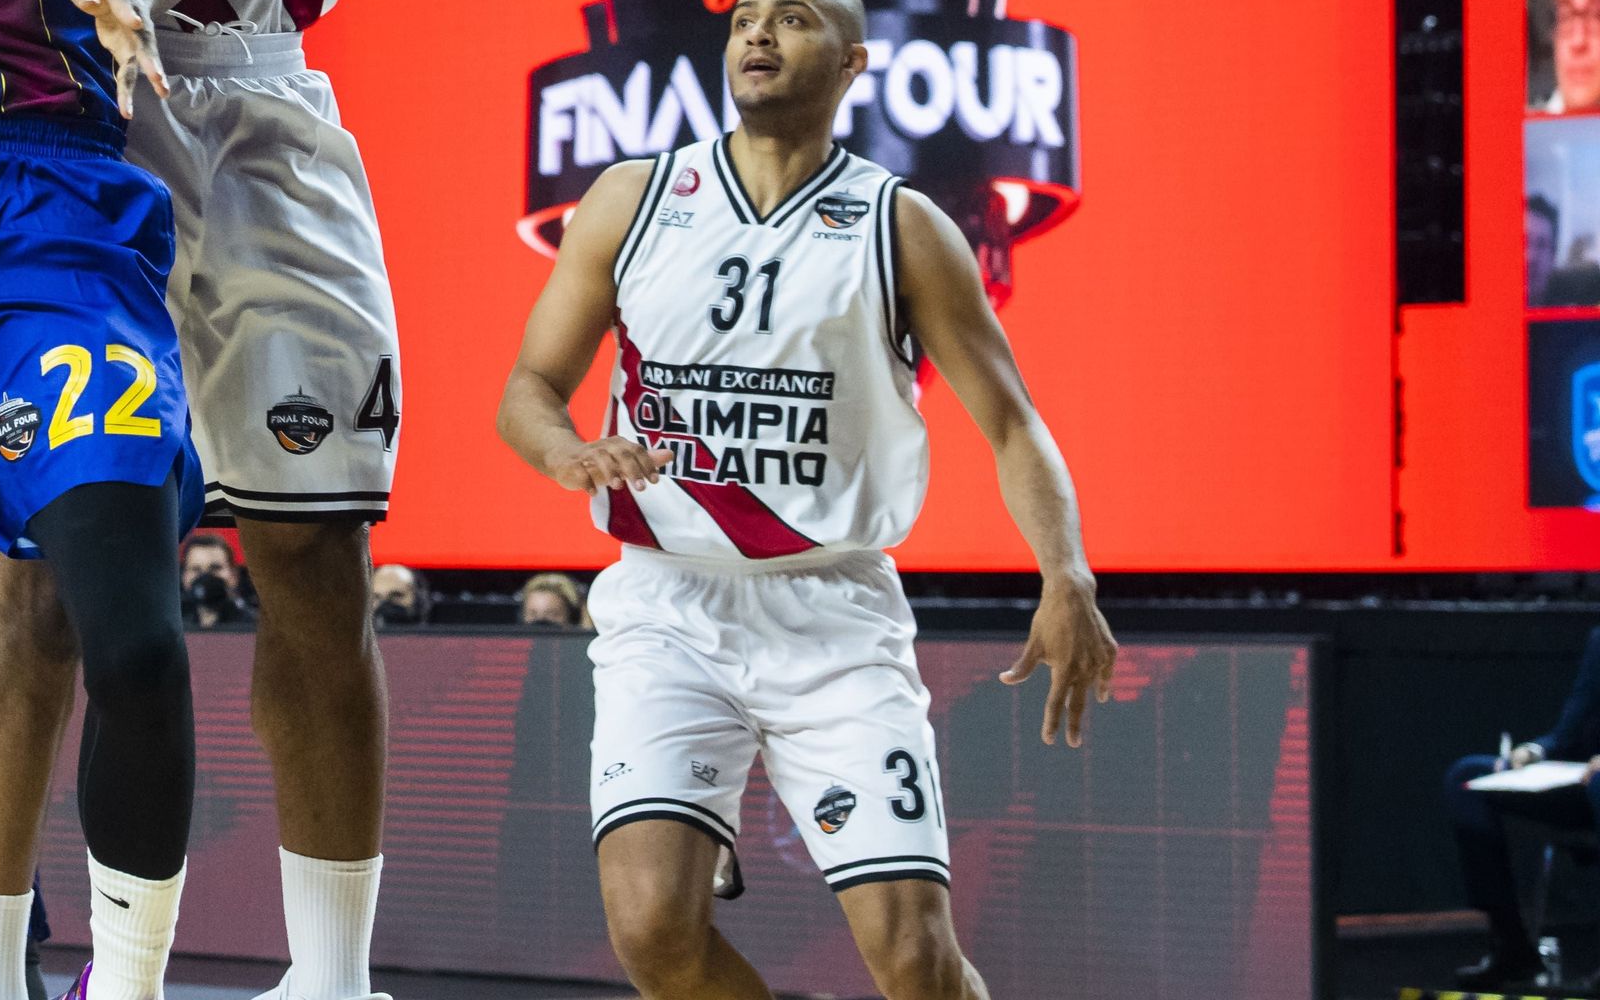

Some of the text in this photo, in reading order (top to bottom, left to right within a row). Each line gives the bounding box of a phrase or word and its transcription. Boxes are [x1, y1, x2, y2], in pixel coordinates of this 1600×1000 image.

[832, 39, 1065, 147] FOUR
[658, 208, 694, 223] EA7
[707, 253, 784, 335] 31
[40, 344, 162, 451] 22
[720, 370, 834, 395] EXCHANGE
[14, 412, 38, 428] FOUR
[270, 414, 329, 428] FINAL FOUR
[635, 391, 828, 445] OLIMPIA
